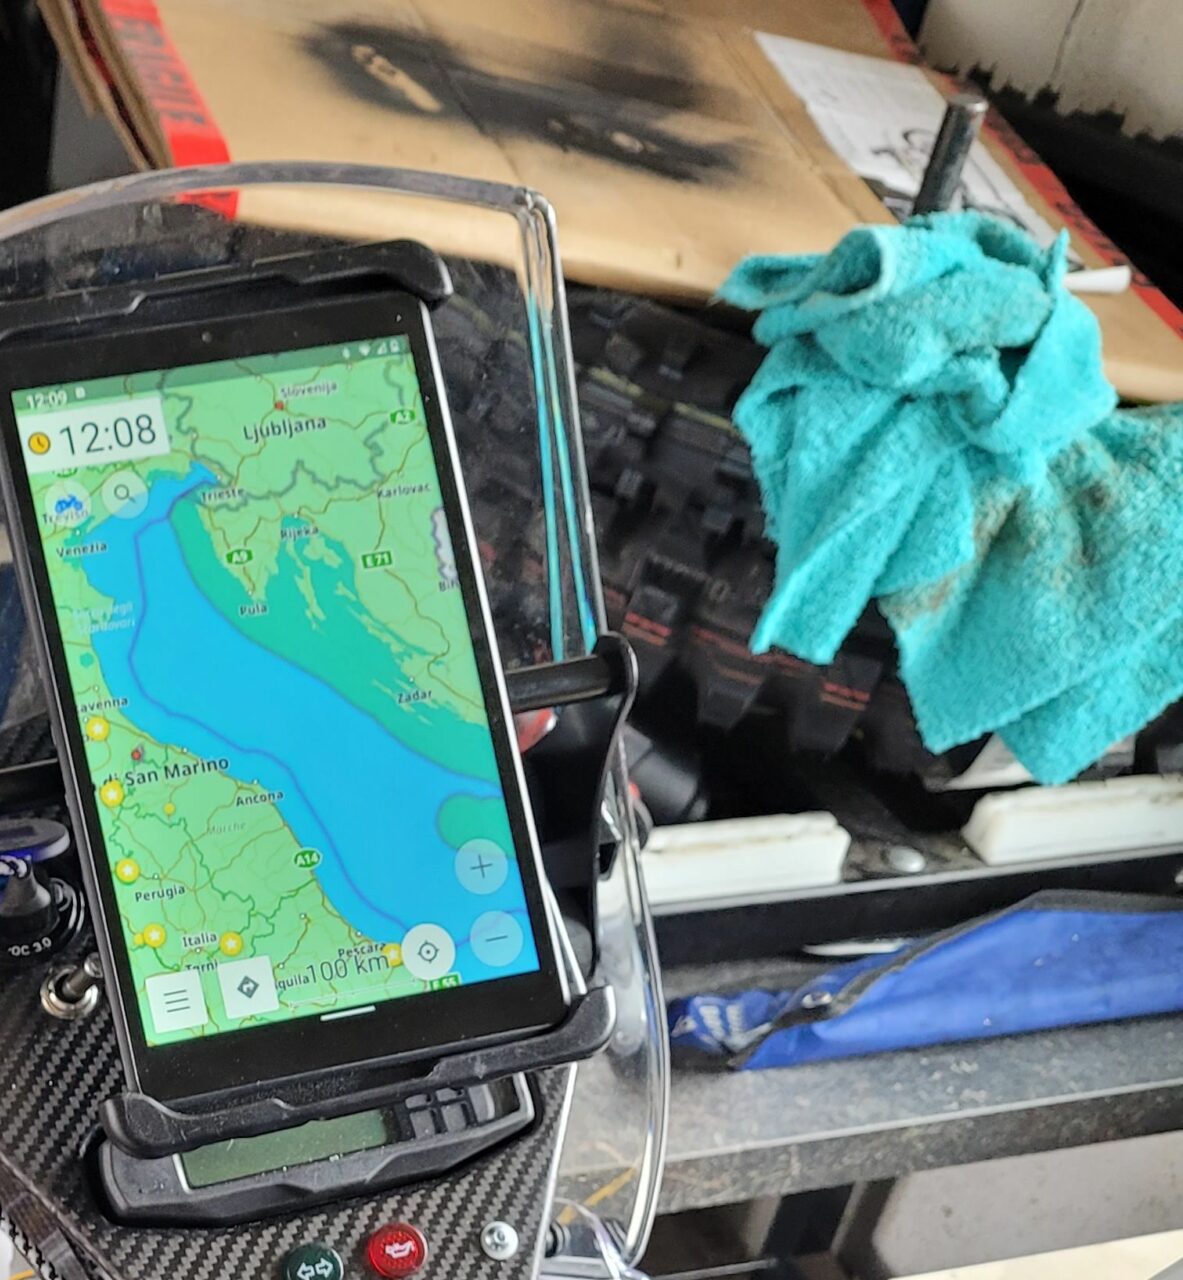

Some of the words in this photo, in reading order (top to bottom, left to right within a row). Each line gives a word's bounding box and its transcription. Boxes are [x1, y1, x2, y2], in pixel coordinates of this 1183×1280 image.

[281, 382, 337, 398] Slovenija
[26, 389, 68, 409] 12:09
[59, 413, 156, 456] 12:08
[243, 416, 327, 443] Ljubljana
[202, 487, 245, 502] Trieste
[376, 483, 432, 499] Karlovac
[280, 526, 319, 542] Rijeka
[56, 542, 107, 558] Venezia
[239, 603, 268, 617] Pula
[78, 697, 128, 713] avenna
[397, 689, 433, 705] Zadar
[125, 769, 159, 788] San
[164, 757, 229, 781] Marino
[235, 790, 284, 807] Ancona
[296, 852, 319, 867] A14
[134, 884, 186, 903] Perugia
[182, 932, 218, 948] Italia
[305, 957, 349, 984] 100
[355, 954, 390, 976] km
